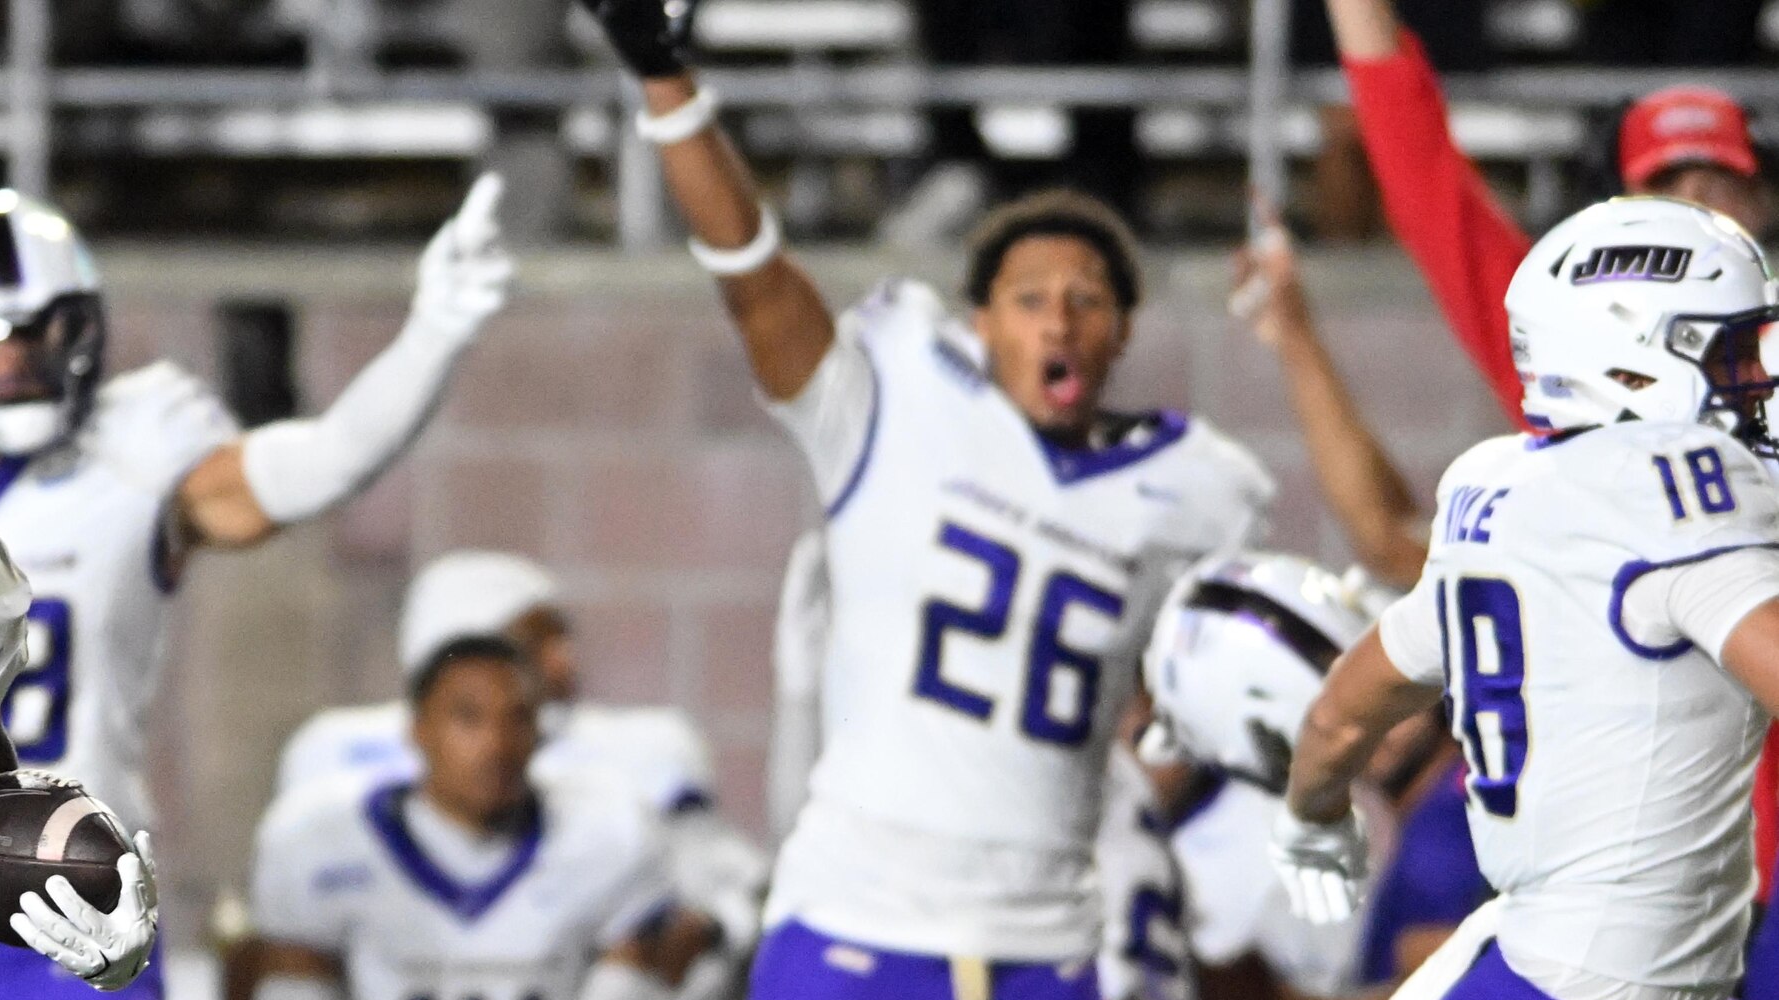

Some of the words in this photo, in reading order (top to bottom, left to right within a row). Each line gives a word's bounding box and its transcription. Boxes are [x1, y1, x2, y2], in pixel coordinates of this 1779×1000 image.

[1572, 245, 1693, 285] JMU
[1652, 446, 1736, 520] 18
[912, 519, 1125, 749] 26
[1436, 576, 1530, 819] 18
